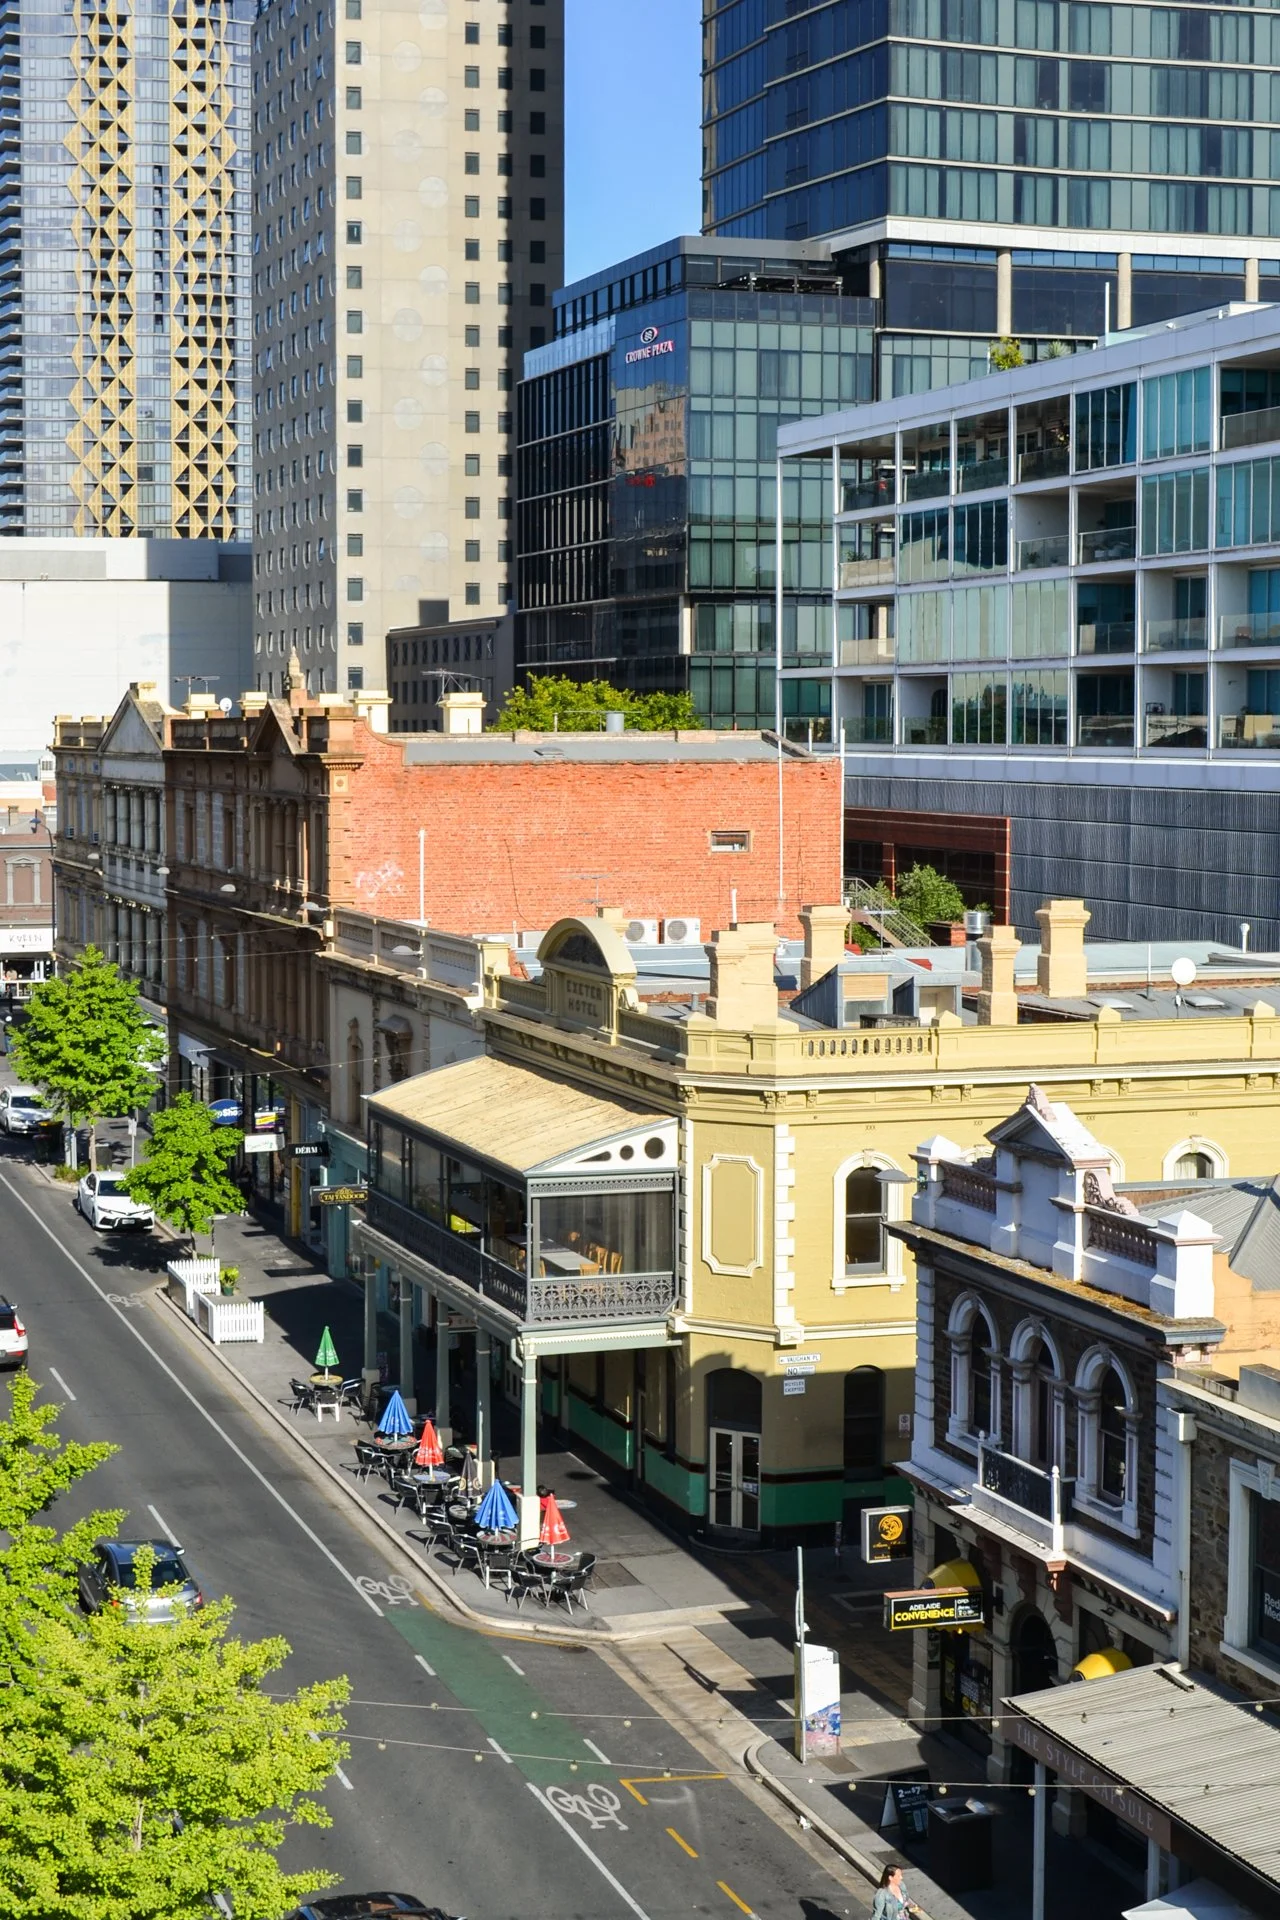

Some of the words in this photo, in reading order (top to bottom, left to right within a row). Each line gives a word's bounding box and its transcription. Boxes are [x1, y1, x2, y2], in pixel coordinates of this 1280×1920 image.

[625, 346, 652, 364] CROWNE
[652, 340, 675, 356] PLAZA
[566, 979, 602, 1001] EXETER
[568, 998, 598, 1018] HOTEL
[787, 1368, 798, 1376] NO
[894, 1608, 955, 1621] CONVENIENCE
[909, 1602, 941, 1611] ADELAIDE
[1016, 1723, 1039, 1752] THE
[1046, 1743, 1086, 1784] STYLE
[1092, 1775, 1154, 1831] CAPSULE
[897, 1789, 905, 1798] 2
